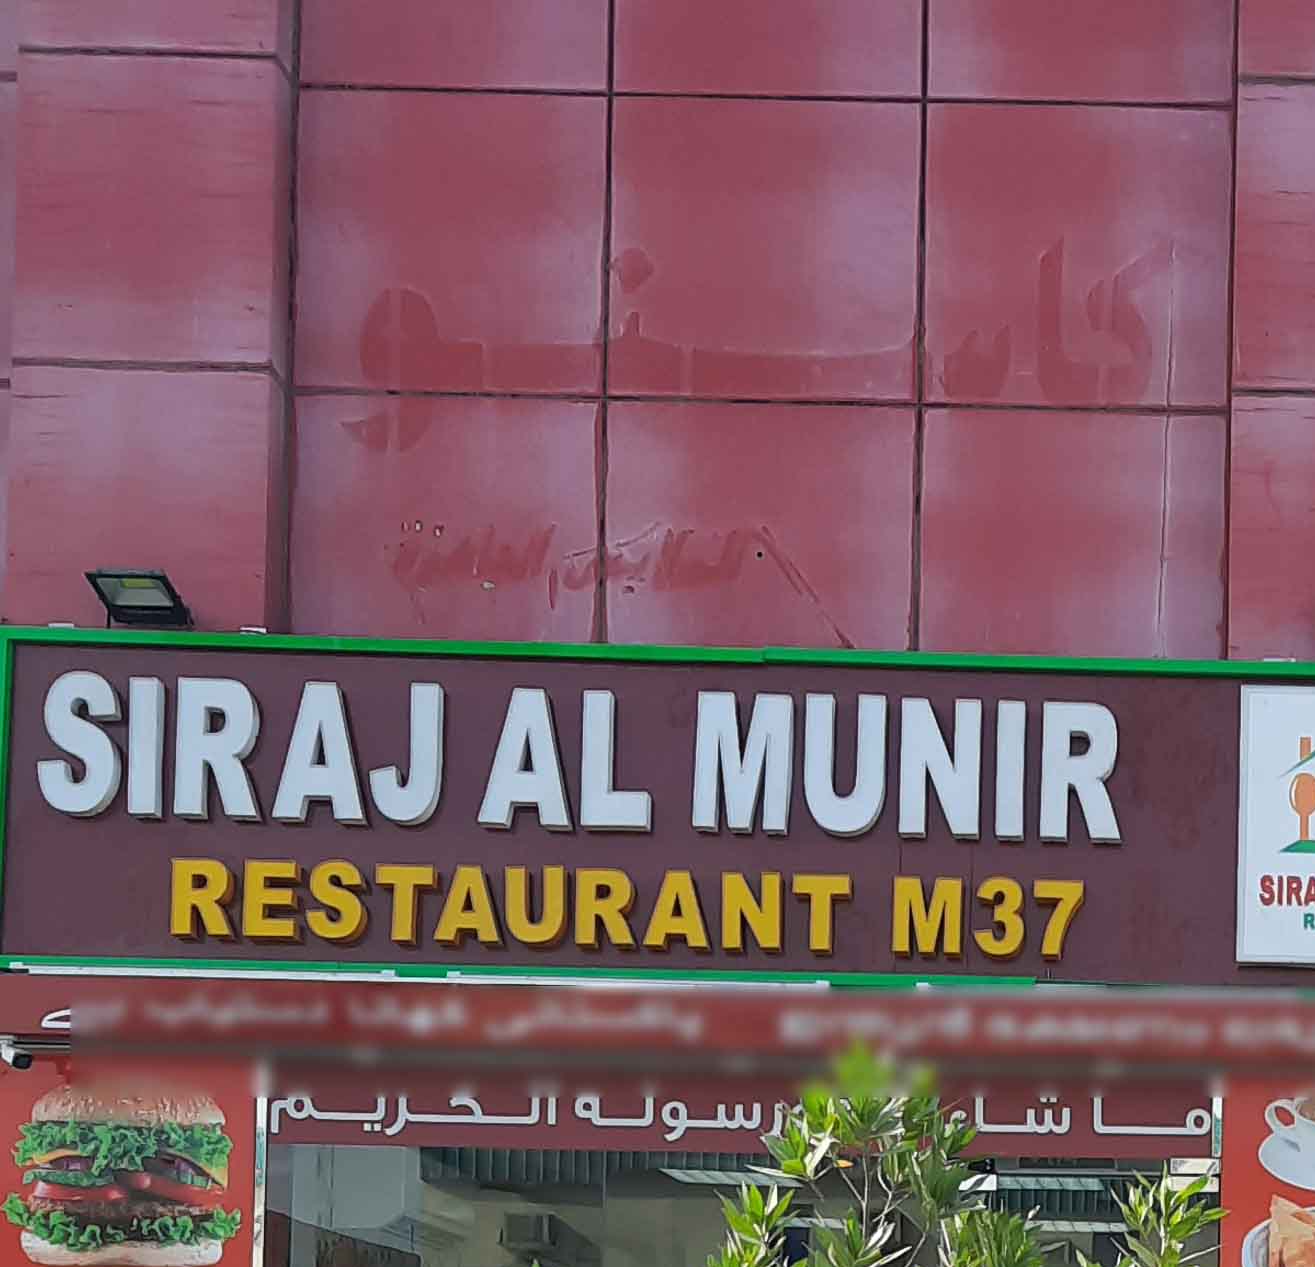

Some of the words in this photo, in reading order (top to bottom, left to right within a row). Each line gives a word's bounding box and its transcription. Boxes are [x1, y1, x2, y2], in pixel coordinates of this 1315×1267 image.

[36, 669, 444, 826] SIRAJ
[477, 686, 653, 832] AL
[691, 691, 1122, 845] MUNIR
[169, 858, 854, 955] RESTAURANT
[891, 875, 1085, 961] M37
[1093, 1087, 1212, 1136] ما
